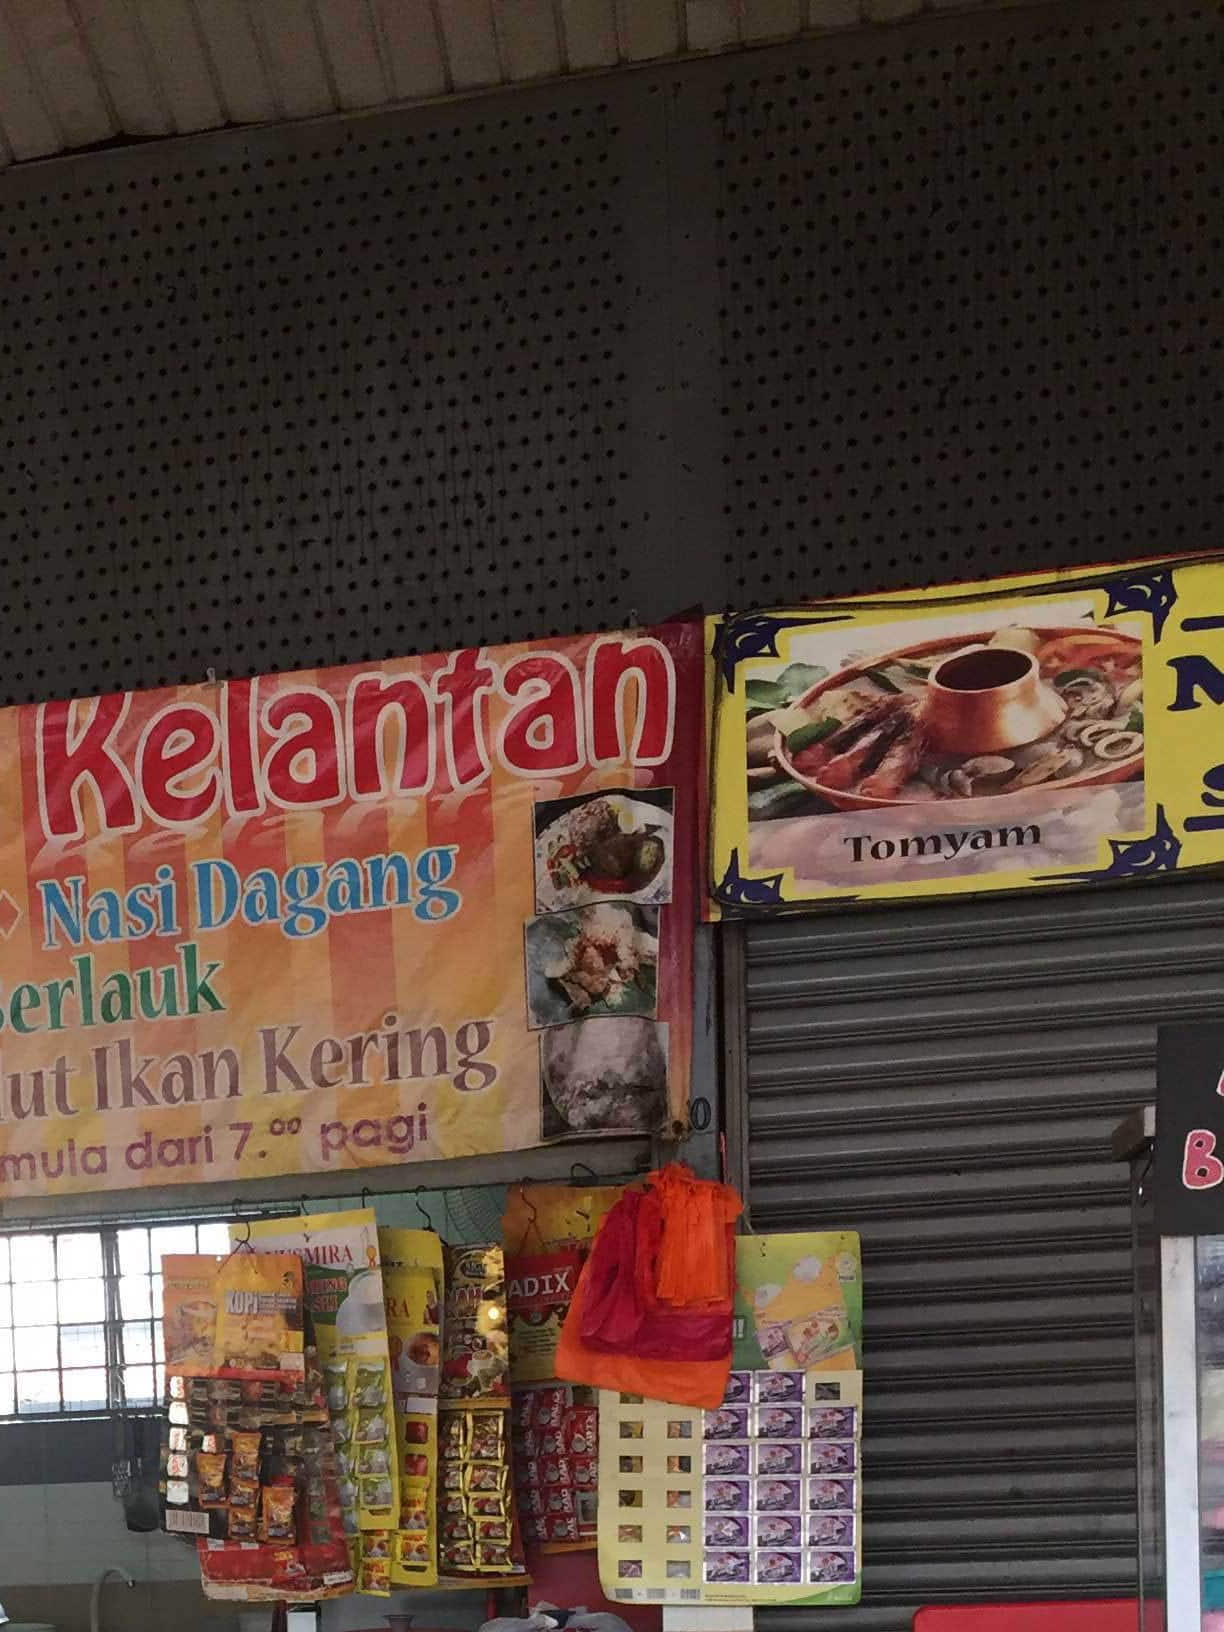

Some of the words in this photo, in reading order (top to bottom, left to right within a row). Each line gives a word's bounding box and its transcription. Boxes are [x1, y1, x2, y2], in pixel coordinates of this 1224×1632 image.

[36, 635, 675, 839] Kelantan
[843, 821, 1042, 864] Tomyam
[37, 866, 180, 950] Nasi
[192, 845, 461, 941] Dagang
[89, 1033, 241, 1113] Ikan
[258, 1013, 499, 1096] Kering
[125, 1129, 214, 1170] dari
[318, 1102, 429, 1160] pagi
[508, 1271, 572, 1298] ADIX
